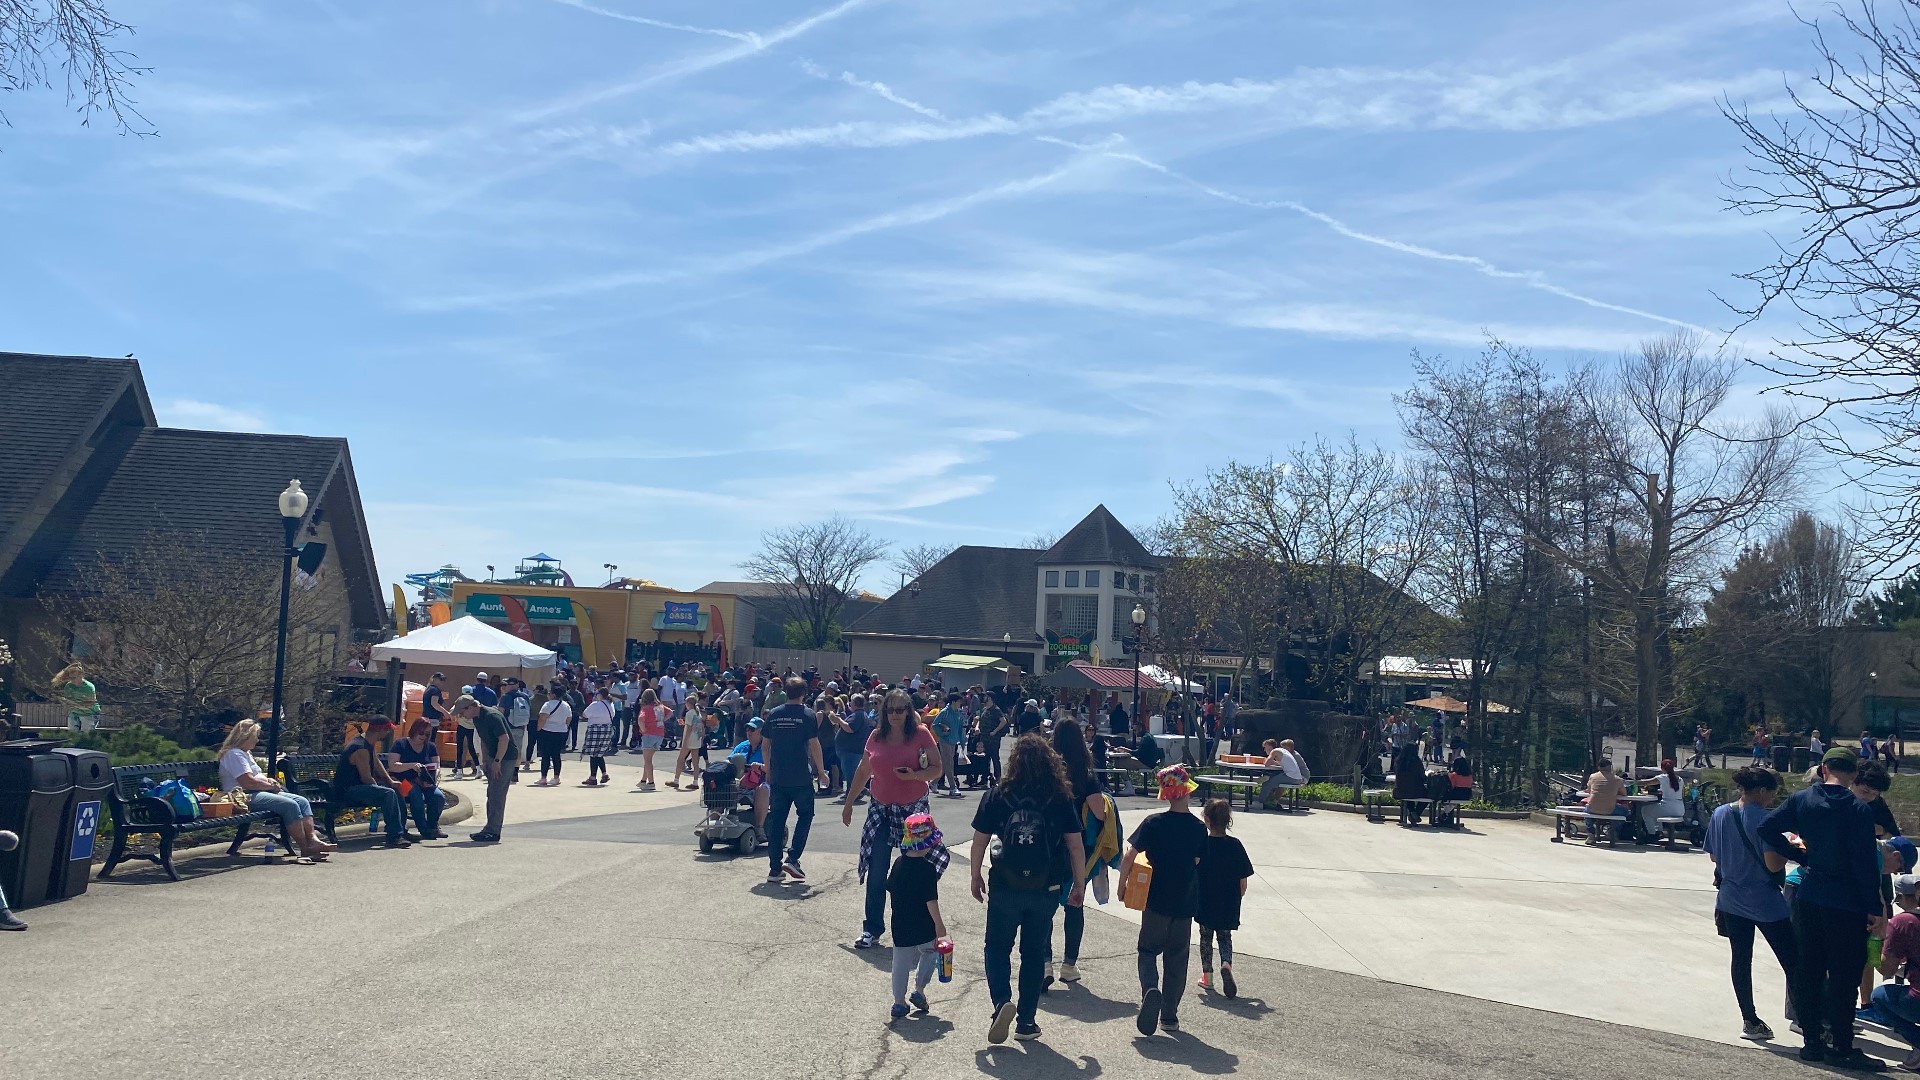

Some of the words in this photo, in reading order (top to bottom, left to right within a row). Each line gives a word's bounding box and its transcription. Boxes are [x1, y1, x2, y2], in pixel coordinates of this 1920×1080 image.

[529, 604, 562, 614] Anne's
[669, 612, 693, 620] OASIS
[1050, 643, 1089, 651] ZOOKEEPER
